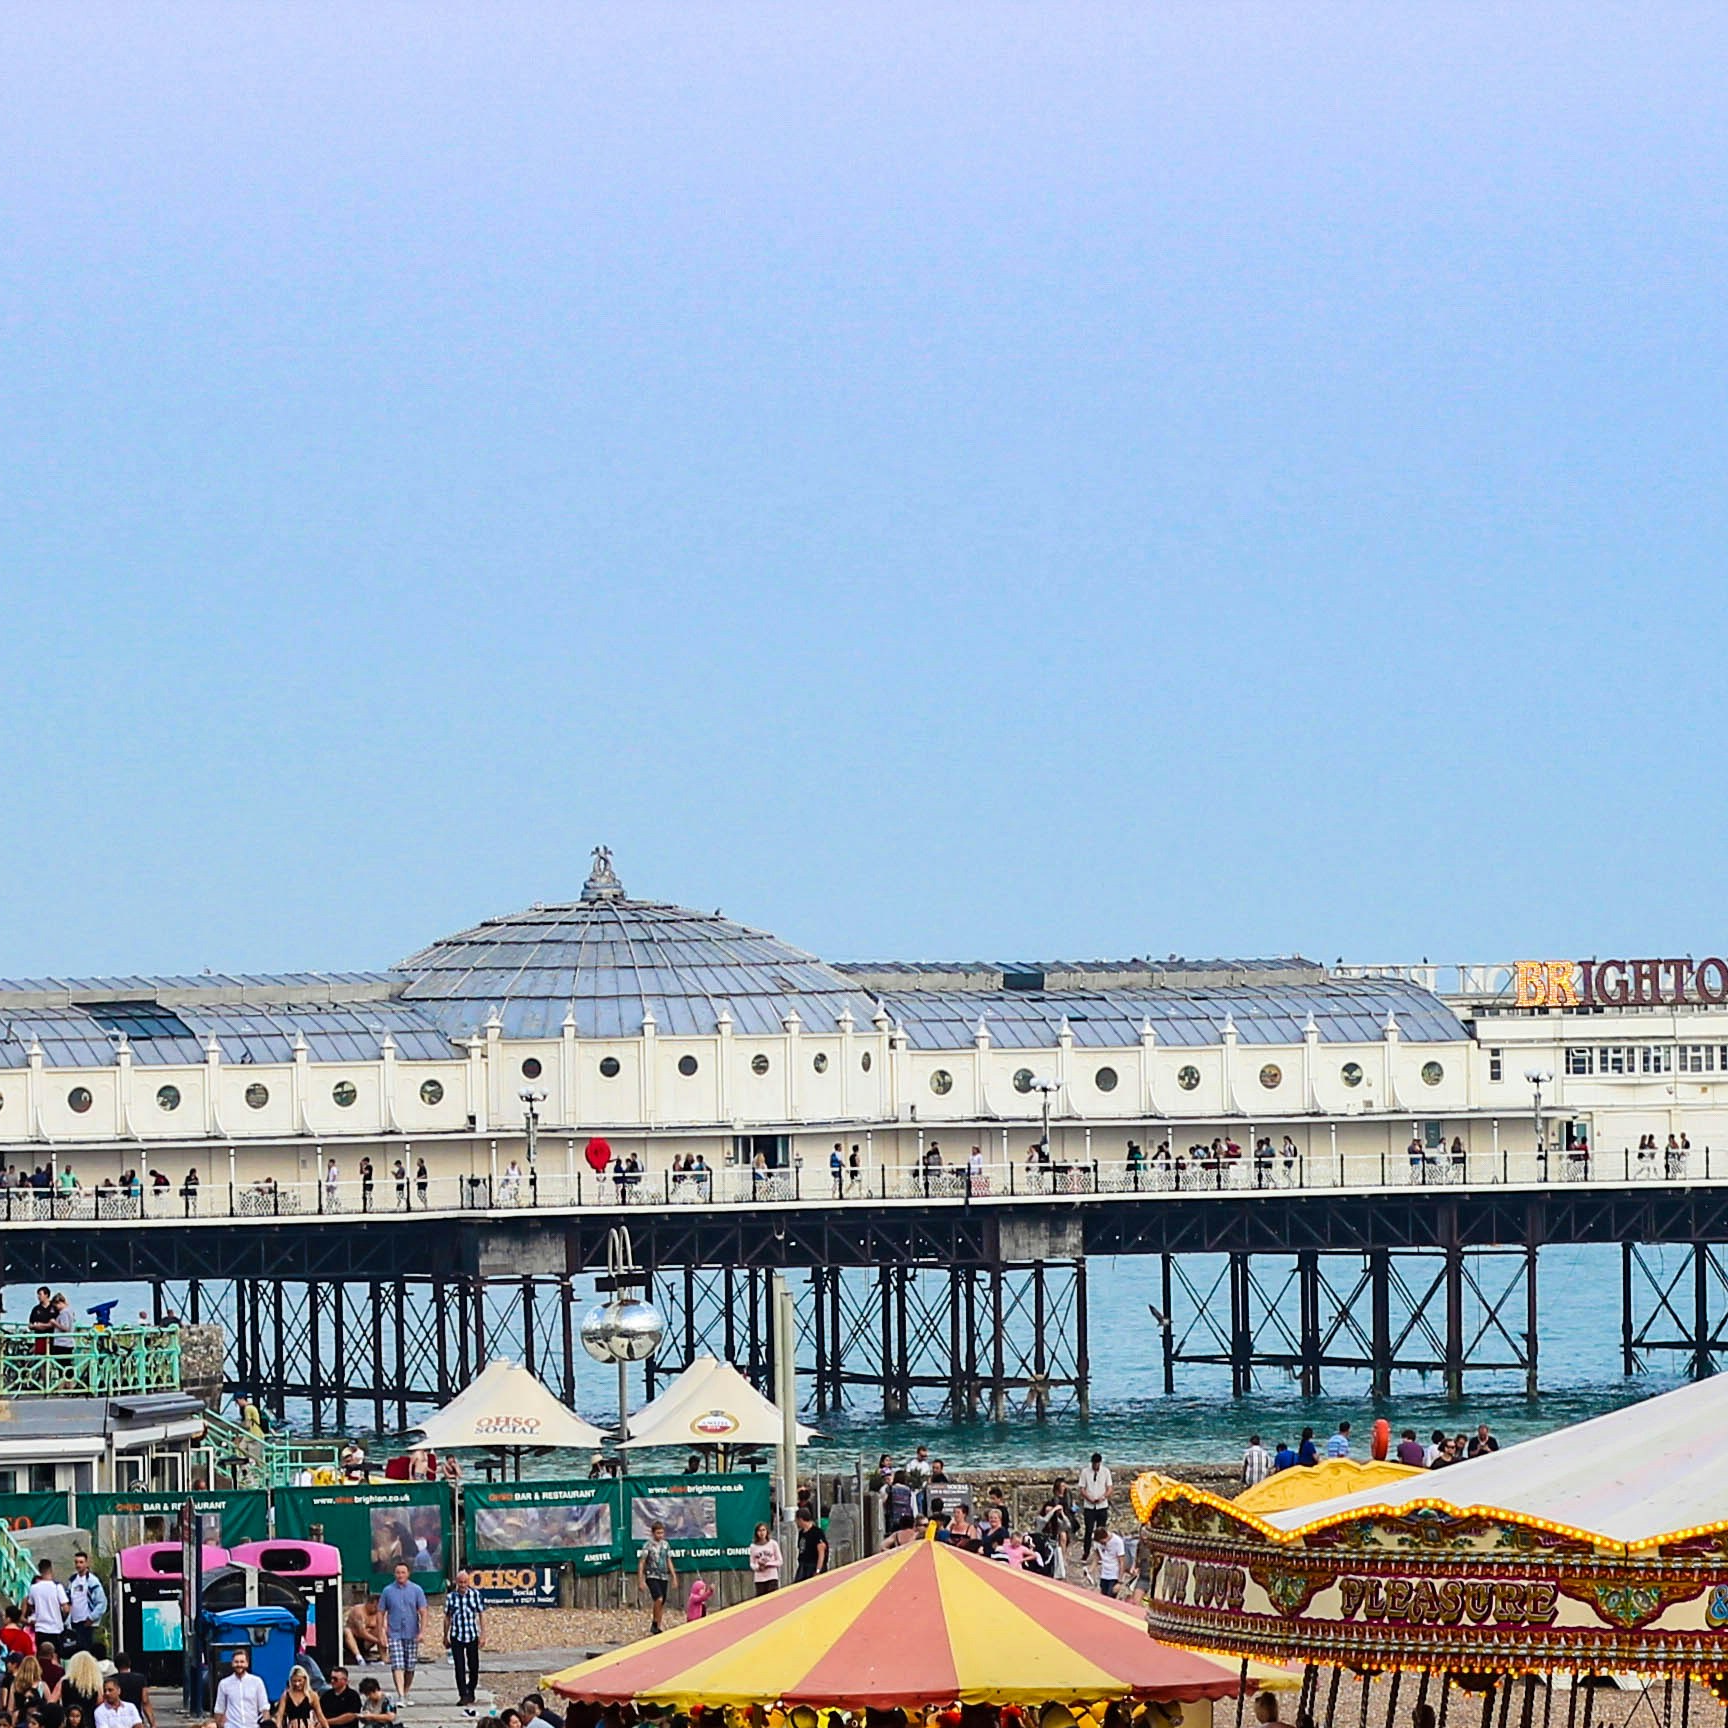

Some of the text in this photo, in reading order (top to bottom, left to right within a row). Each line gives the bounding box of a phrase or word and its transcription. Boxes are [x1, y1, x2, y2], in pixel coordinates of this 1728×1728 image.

[476, 1415, 541, 1428] OHSO
[474, 1425, 540, 1434] SOCIAL
[514, 1492, 532, 1501] BAR
[534, 1491, 541, 1500] &
[542, 1489, 596, 1500] RESTAURANT
[143, 1503, 161, 1511] BAR
[162, 1503, 169, 1511] &
[583, 1552, 611, 1562] AMSTEL
[691, 1548, 721, 1557] LUNCH
[471, 1568, 536, 1590] OHSO
[512, 1588, 537, 1597] Social
[1339, 1576, 1560, 1624] PLEASURE
